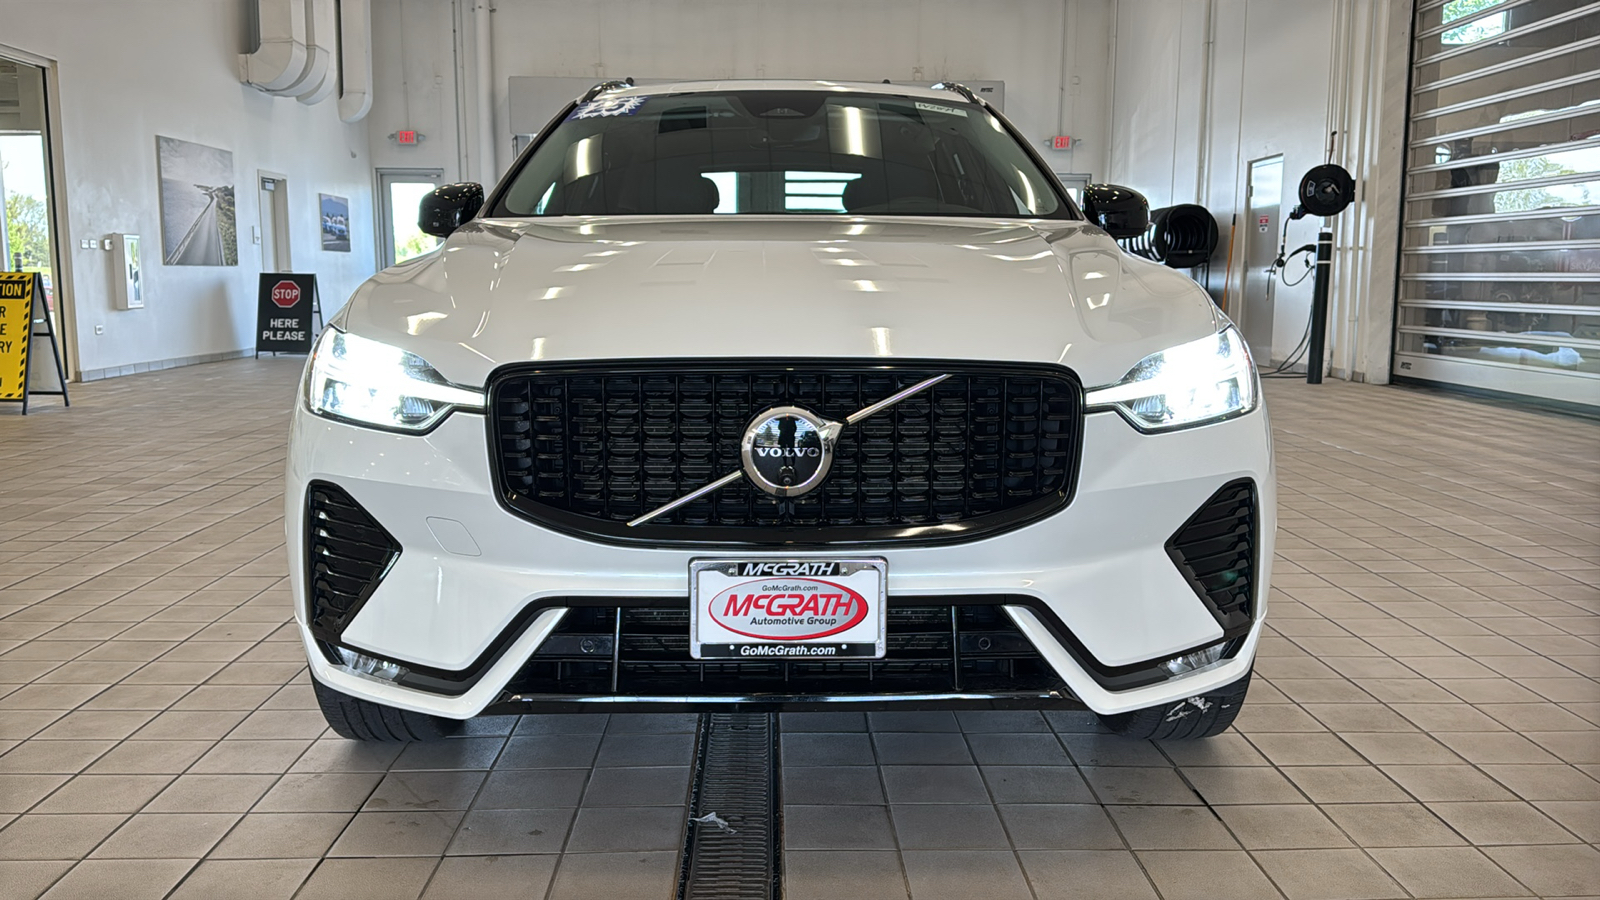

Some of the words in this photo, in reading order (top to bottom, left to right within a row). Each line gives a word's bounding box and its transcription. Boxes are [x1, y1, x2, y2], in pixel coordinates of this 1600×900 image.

[399, 131, 414, 143] EXIT
[1054, 136, 1070, 148] EXIT
[273, 289, 299, 299] STOP
[270, 318, 299, 328] HERE
[262, 331, 306, 341] PLEASE
[754, 447, 820, 457] VOLVO
[750, 617, 805, 626] Automotive
[807, 617, 837, 627] Group
[740, 645, 836, 656] GoMcGrath.com
